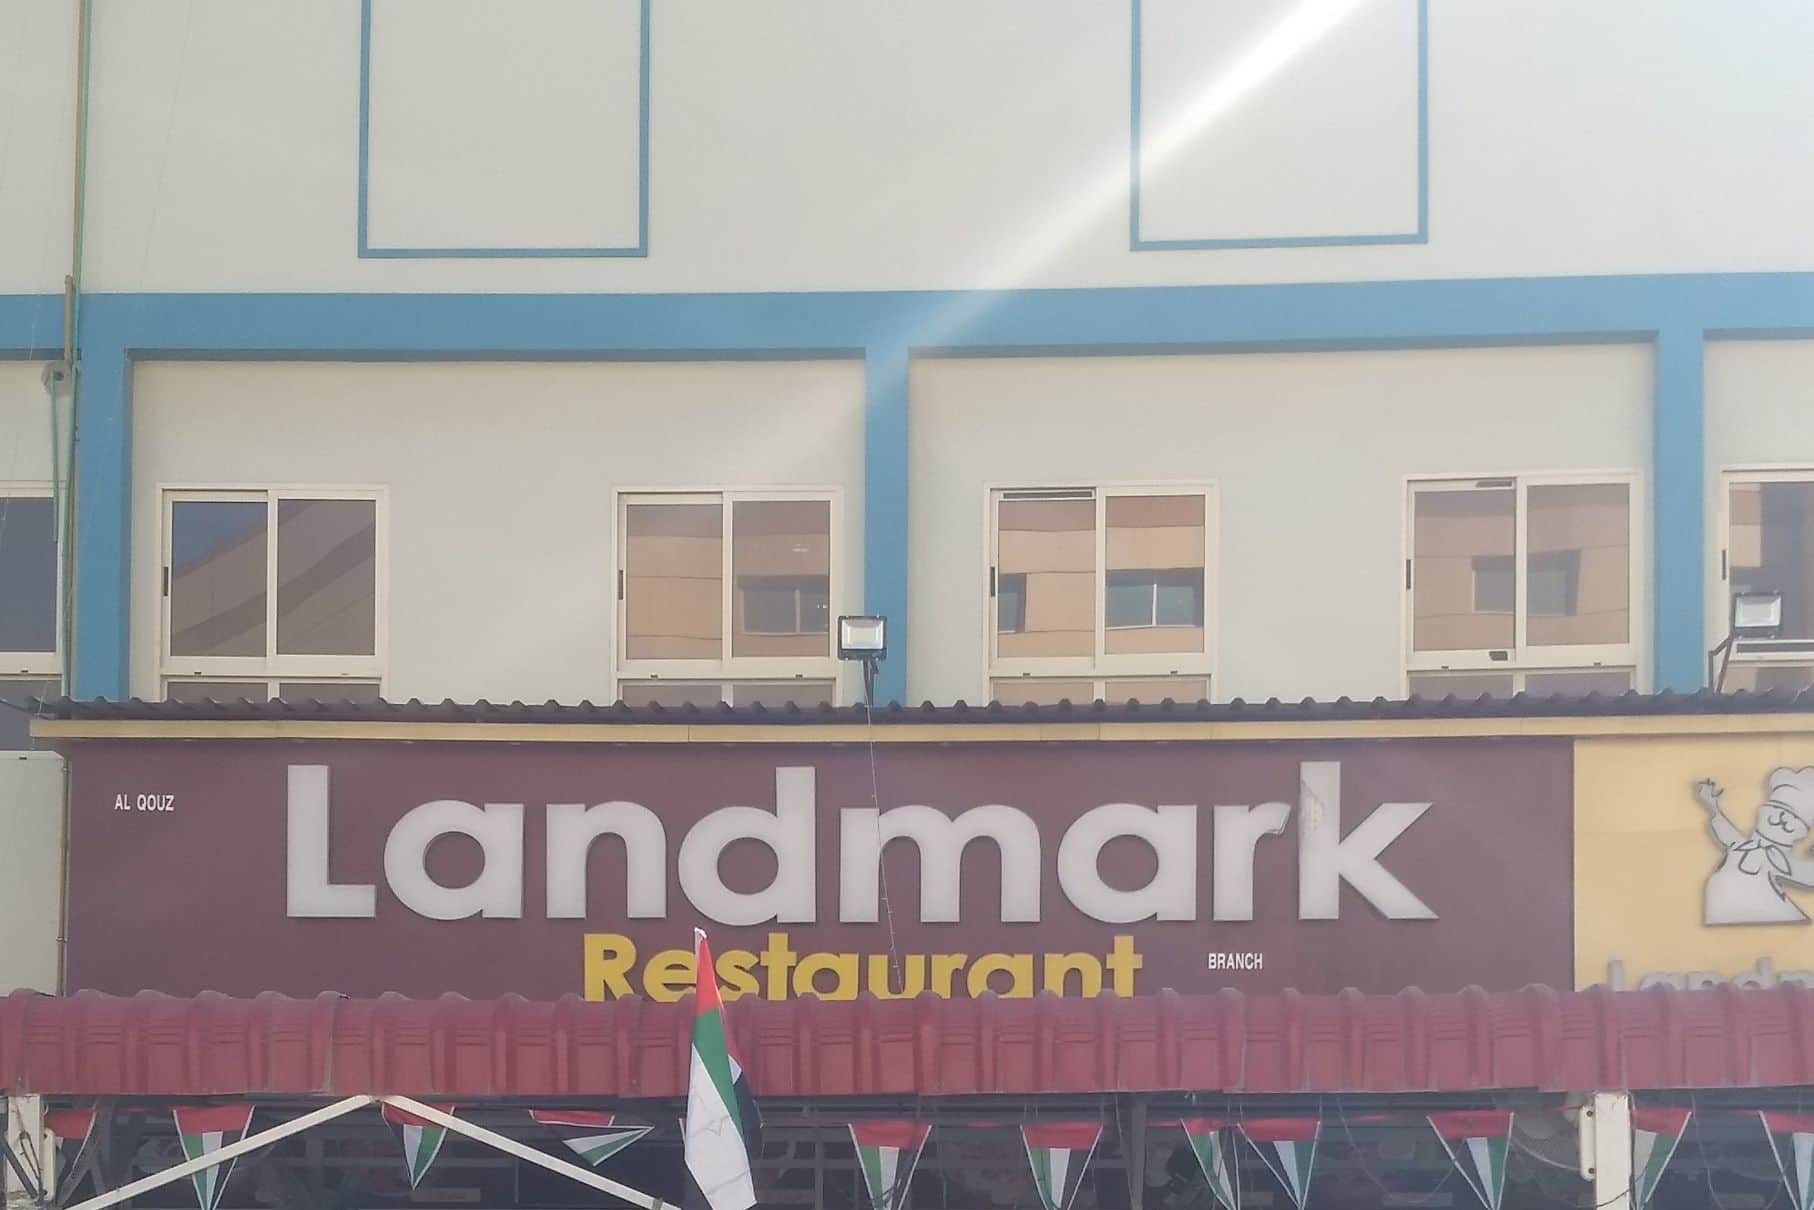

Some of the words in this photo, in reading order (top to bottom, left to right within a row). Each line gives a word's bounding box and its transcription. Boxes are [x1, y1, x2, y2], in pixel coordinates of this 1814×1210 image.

[114, 794, 131, 810] AL
[137, 794, 174, 811] QOUZ
[286, 761, 1440, 926] Landmark
[583, 931, 1142, 1003] Restaurant
[1207, 951, 1265, 974] BRANCH
